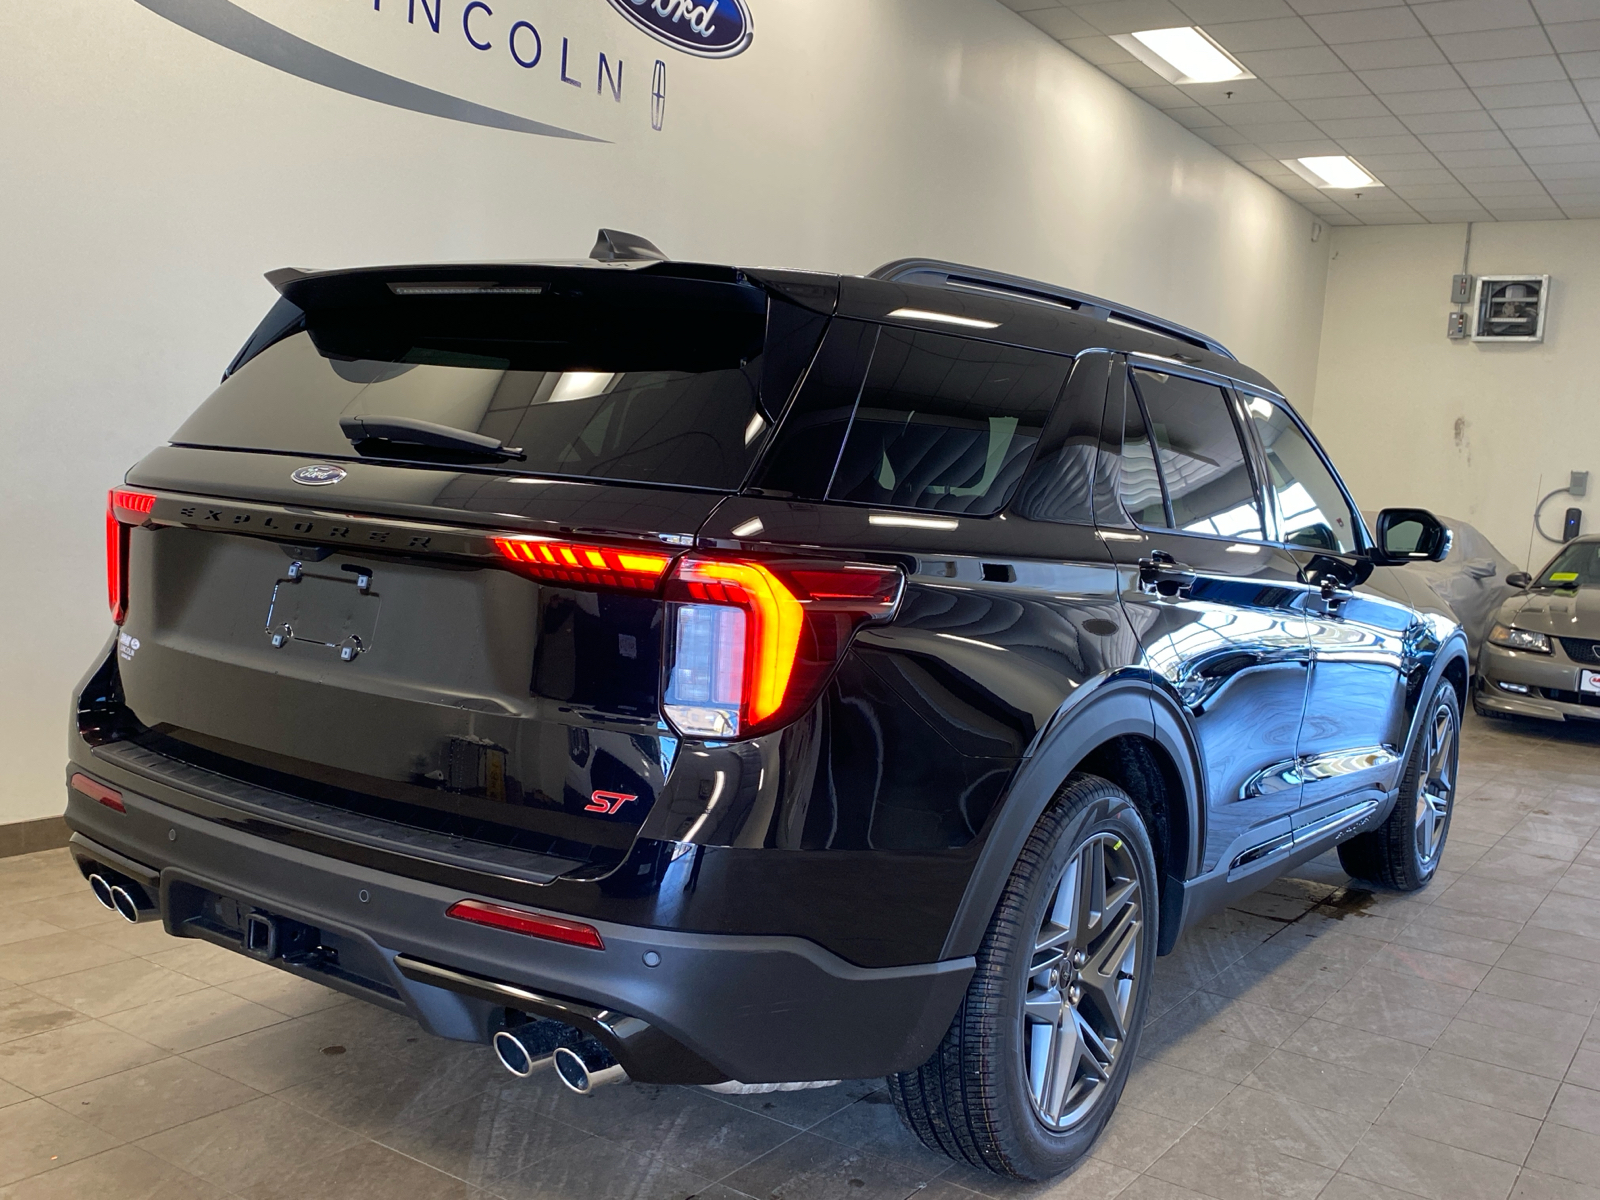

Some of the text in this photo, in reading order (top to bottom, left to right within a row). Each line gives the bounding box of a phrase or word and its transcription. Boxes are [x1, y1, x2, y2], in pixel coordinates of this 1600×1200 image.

[631, 0, 719, 37] ord
[374, 0, 623, 102] NCOLN
[181, 508, 432, 549] EXPLORER
[584, 789, 638, 814] ST
